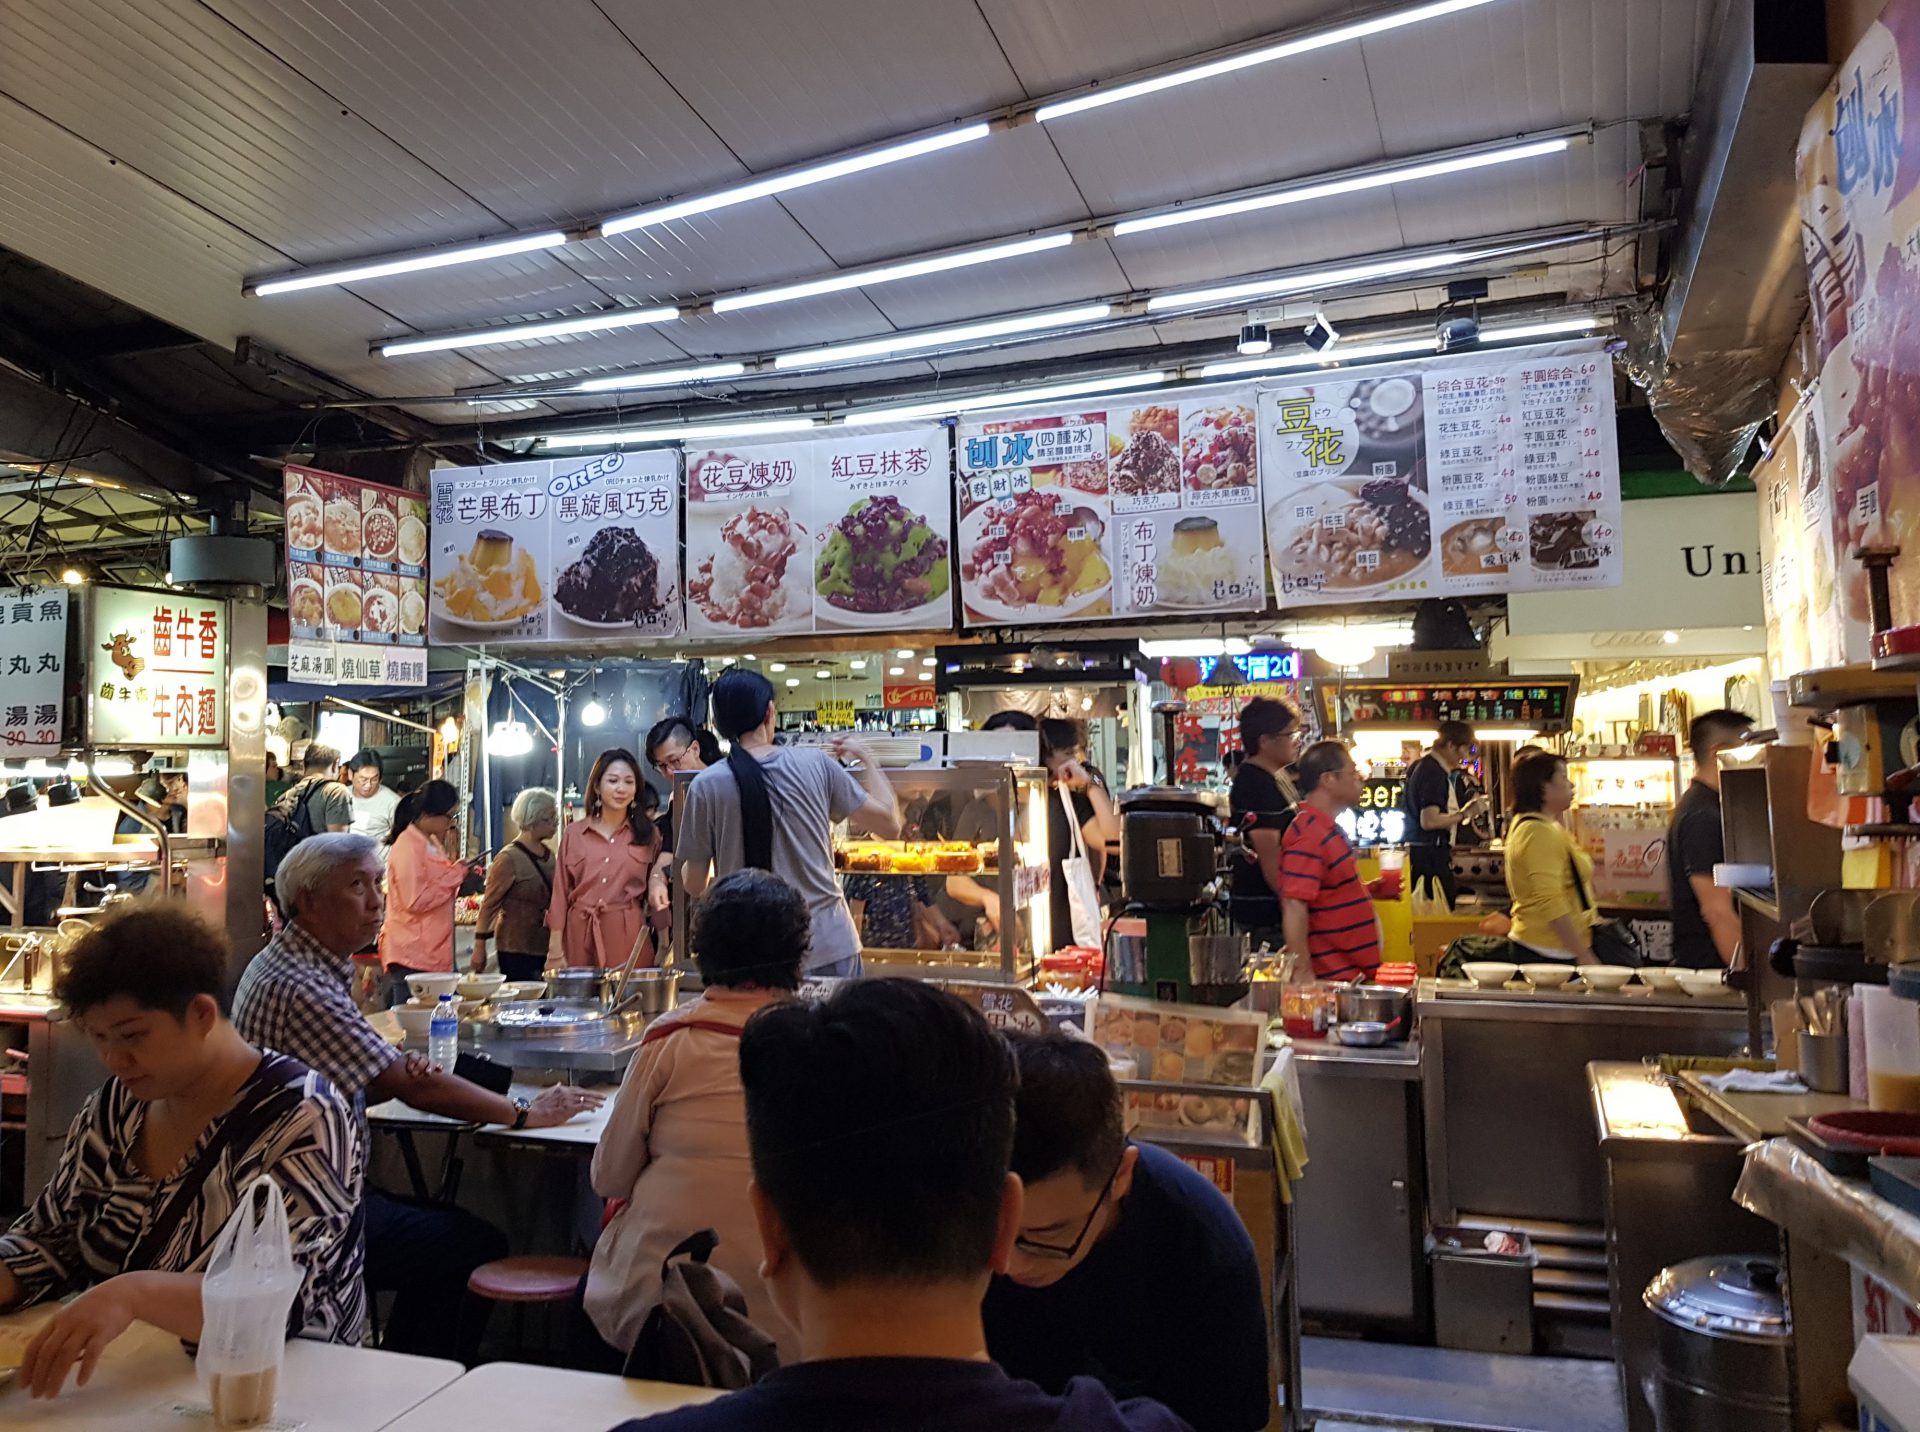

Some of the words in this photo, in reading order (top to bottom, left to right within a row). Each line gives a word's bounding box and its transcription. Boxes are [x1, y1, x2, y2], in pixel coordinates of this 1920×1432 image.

[1437, 376, 1489, 393] 綜合豆花
[1521, 366, 1573, 384] 芋圓綜合
[1313, 408, 1331, 418] ドウ
[1521, 407, 1566, 420] 紅豆豆花
[1277, 396, 1345, 468] 豆花
[1438, 420, 1482, 434] 花生豆花
[1523, 429, 1567, 442] 芋圓豆花
[1036, 427, 1093, 448] (四種冰)
[831, 448, 928, 478] 紅豆抹茶
[548, 453, 625, 496] OREO
[703, 460, 793, 489] 花豆煉奶
[1441, 472, 1484, 485] 粉圓豆花
[973, 474, 1029, 497] 發財冰
[458, 492, 544, 520] 芒果布丁
[559, 488, 669, 518] 黑旋風巧克
[1002, 499, 1013, 510] 60
[1132, 496, 1159, 505] 巧克力
[1504, 494, 1517, 504] 50
[1296, 506, 1315, 517] 豆花
[1324, 515, 1343, 526] 花生
[1507, 529, 1523, 543] 40
[1594, 525, 1612, 539] 40
[1134, 521, 1156, 605] 布丁煉奶
[153, 606, 218, 659] 齒牛香
[5, 602, 34, 727] 貢丸湯
[35, 600, 63, 726] 魚丸湯
[290, 655, 334, 675] 芝麻湯圓
[342, 657, 381, 681] 燒仙草
[152, 685, 217, 737] 牛肉麵
[1359, 785, 1402, 808] eer
